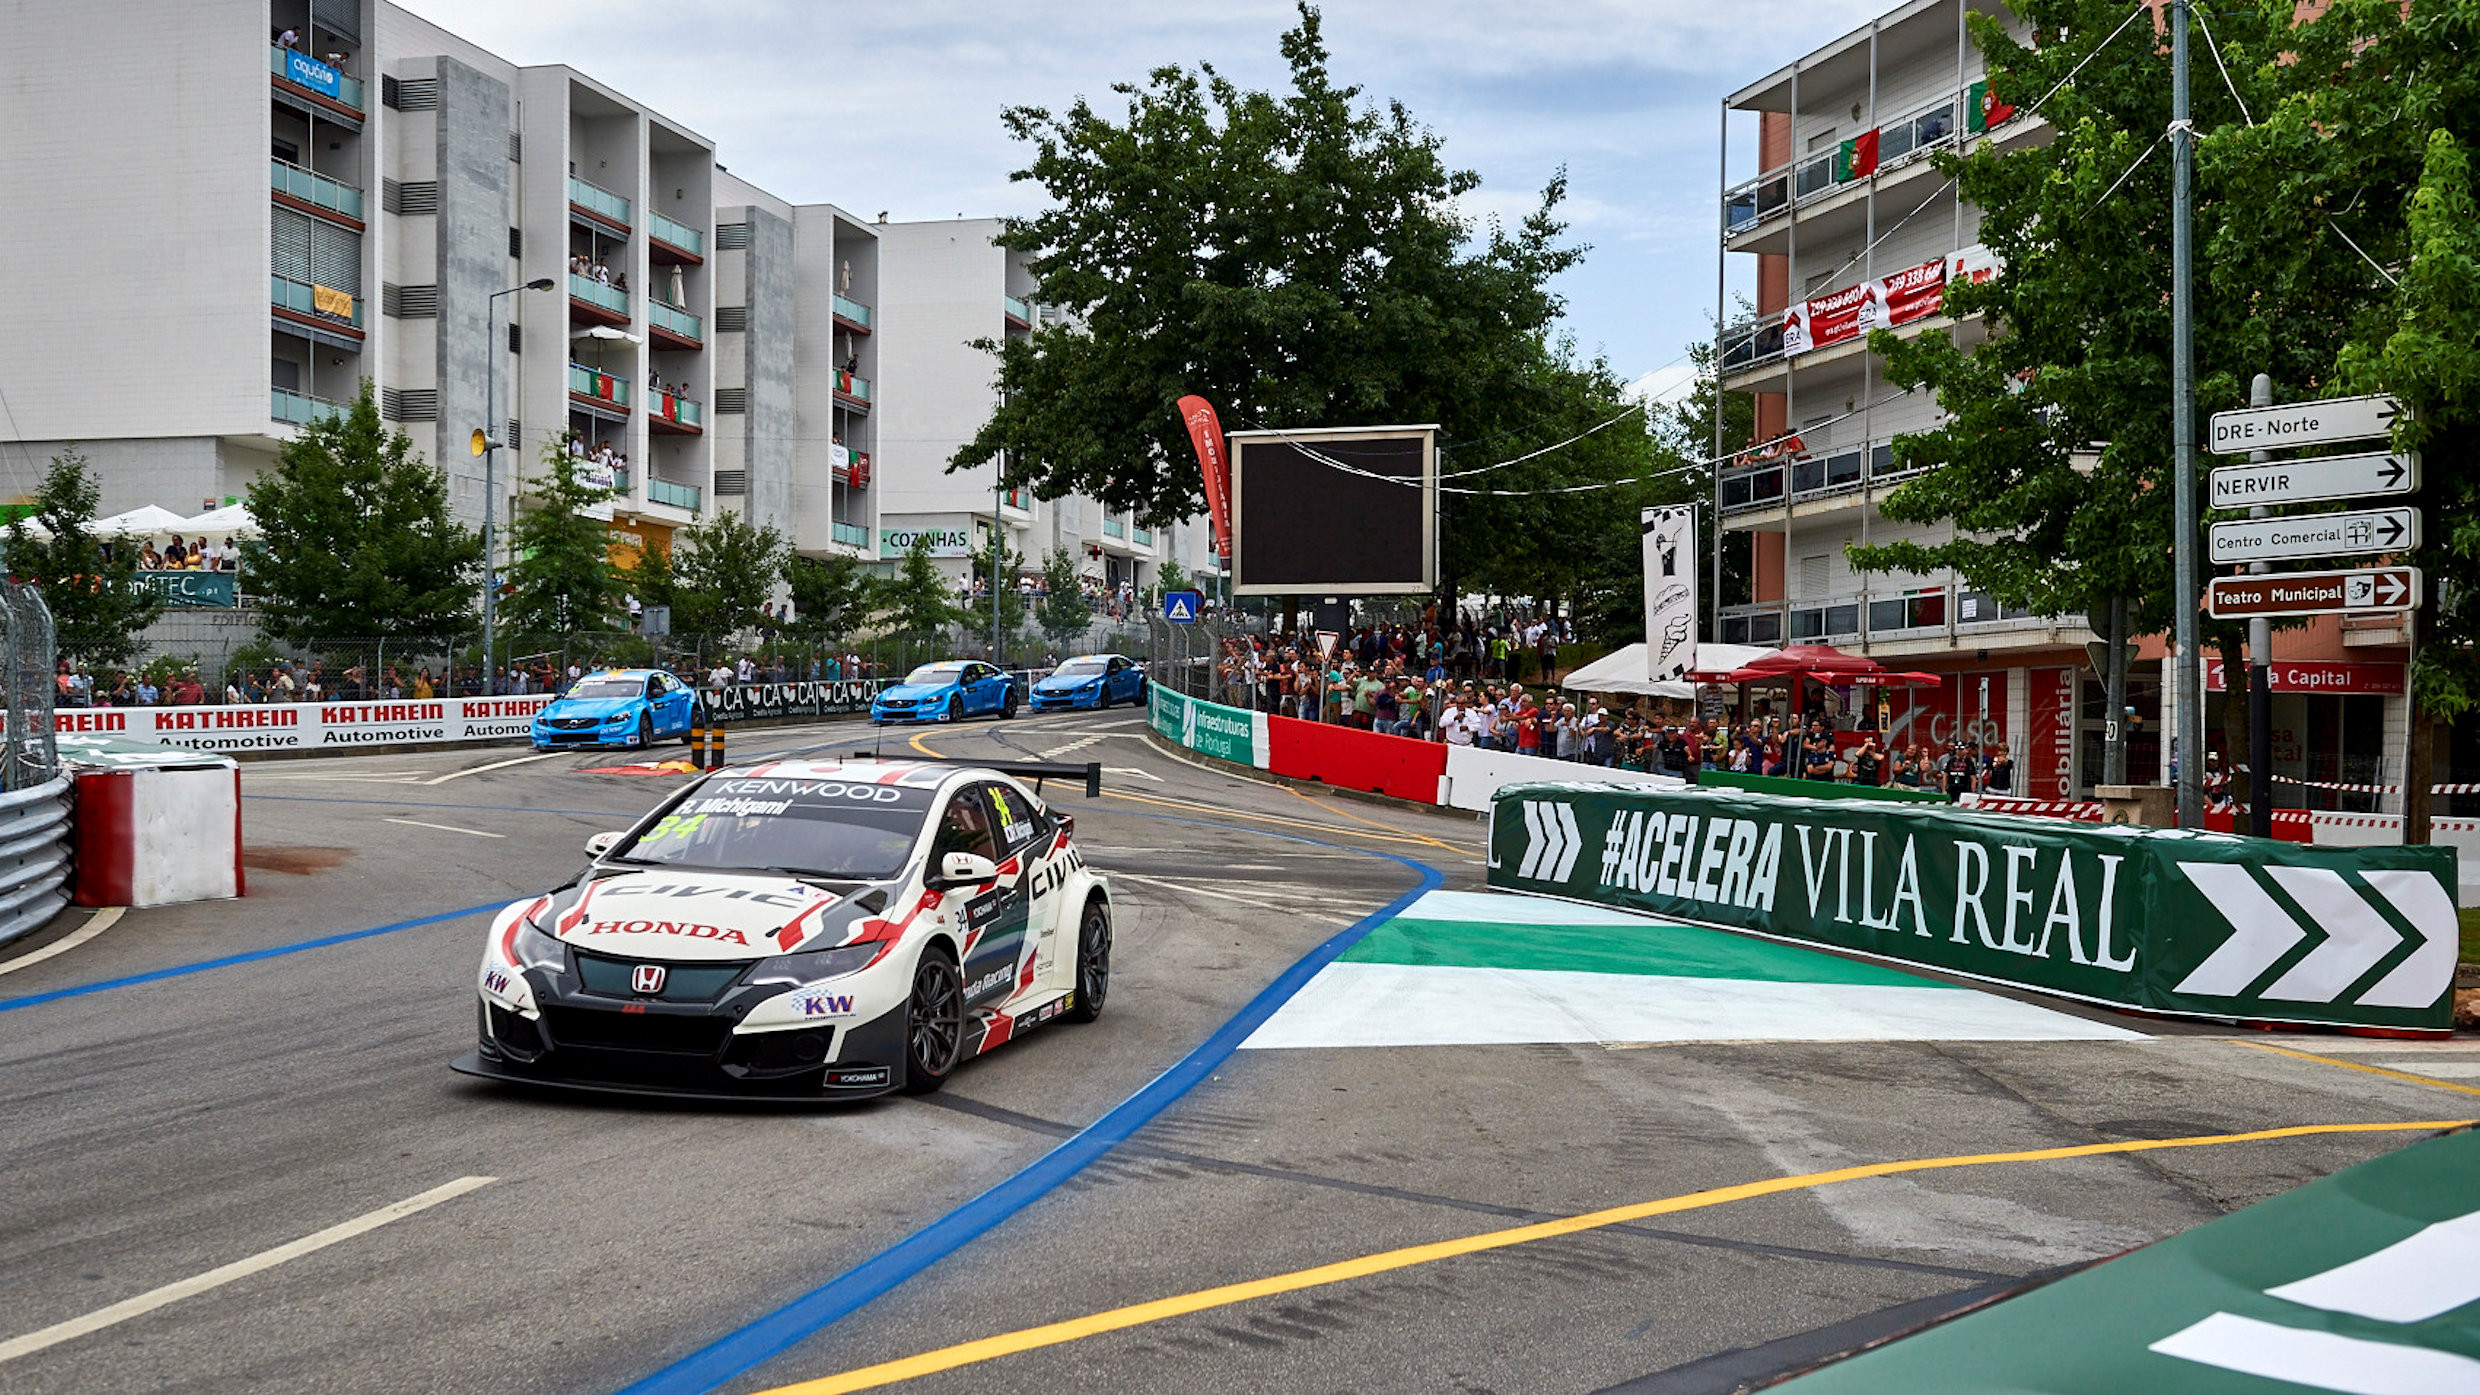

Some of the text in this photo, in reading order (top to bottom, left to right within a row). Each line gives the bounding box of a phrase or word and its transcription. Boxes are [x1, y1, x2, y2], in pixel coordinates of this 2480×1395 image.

[1859, 306, 1877, 320] ERA
[1785, 331, 1801, 345] ERA
[2217, 475, 2290, 497] NERVIR
[890, 532, 967, 548] COZNHAS
[2216, 528, 2342, 550] Centro Comercial
[106, 574, 196, 596] nfiTEC
[2215, 584, 2343, 605] Teatro Municipal
[212, 614, 261, 626] EDIFIC
[2287, 669, 2351, 688] Capital
[724, 686, 745, 711] CA
[763, 683, 783, 707] CA
[798, 682, 816, 705] CA
[833, 681, 850, 704] CA
[864, 679, 879, 703] CA
[321, 703, 444, 724] KATHREIN
[463, 700, 553, 718] KATHRE
[155, 709, 298, 734] KATHREIN
[464, 724, 532, 737] Automo
[1197, 710, 1250, 739] Infraestruturas
[323, 727, 444, 744] Automotive
[1205, 732, 1232, 758] Portugal
[2055, 669, 2072, 801] obiliária
[715, 780, 901, 803] KENWOOD
[674, 796, 794, 818] R. Michigami
[638, 814, 709, 842] 34
[600, 883, 806, 909] CIVIC
[1600, 809, 2137, 973] #ACELERA VILA REAL
[588, 920, 750, 947] HONDA
[484, 971, 511, 994] KW
[964, 979, 983, 1000] nda
[982, 963, 1014, 991] Racing
[805, 995, 855, 1015] KW
[840, 1073, 878, 1083] YOKOHAMA
